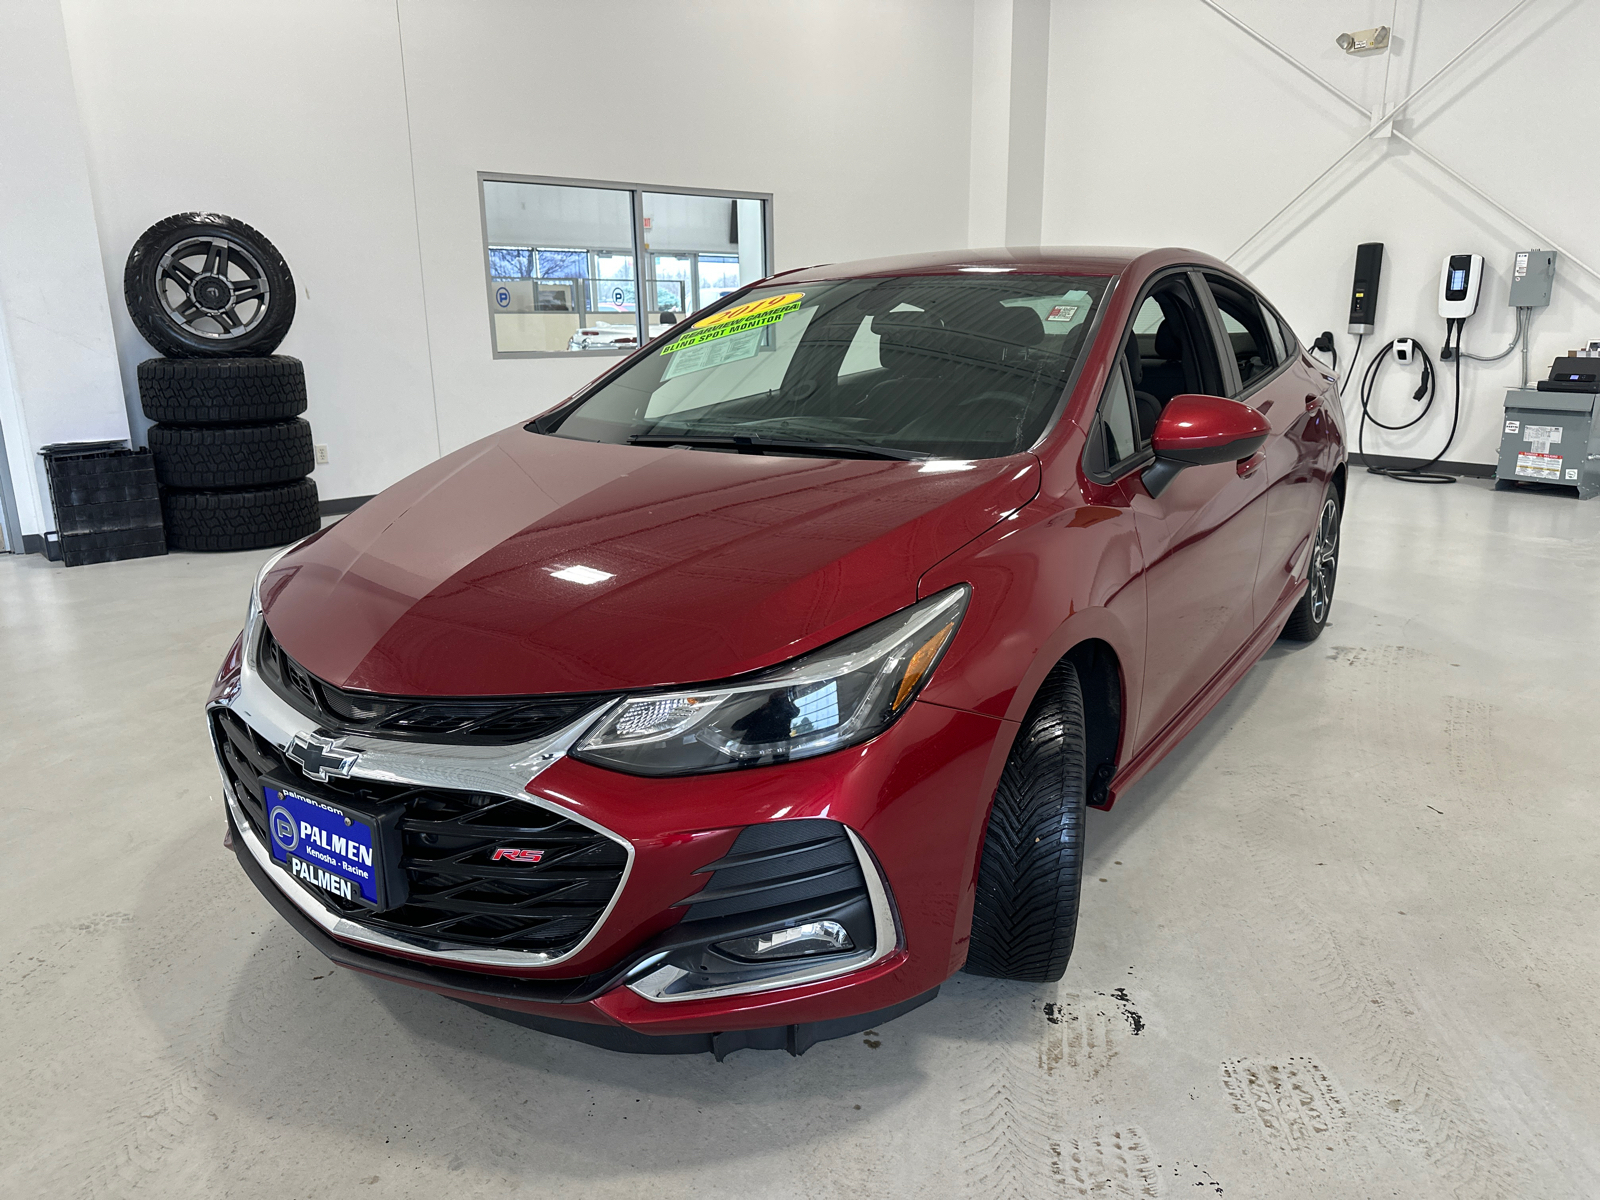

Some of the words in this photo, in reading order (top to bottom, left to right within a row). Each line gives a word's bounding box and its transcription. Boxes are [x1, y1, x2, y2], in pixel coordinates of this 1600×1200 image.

[680, 318, 745, 341] REARVIEW
[744, 303, 798, 321] CAMERA
[709, 296, 786, 324] 2019
[663, 339, 695, 353] BLIND
[698, 329, 726, 343] SPOT
[729, 314, 782, 333] MONITOR
[282, 789, 344, 816] palmen.com
[300, 821, 373, 867] PALMEN
[491, 848, 545, 863] RS
[292, 857, 352, 900] PALMEN
[306, 846, 337, 866] Kenosha
[343, 861, 369, 879] Racine
